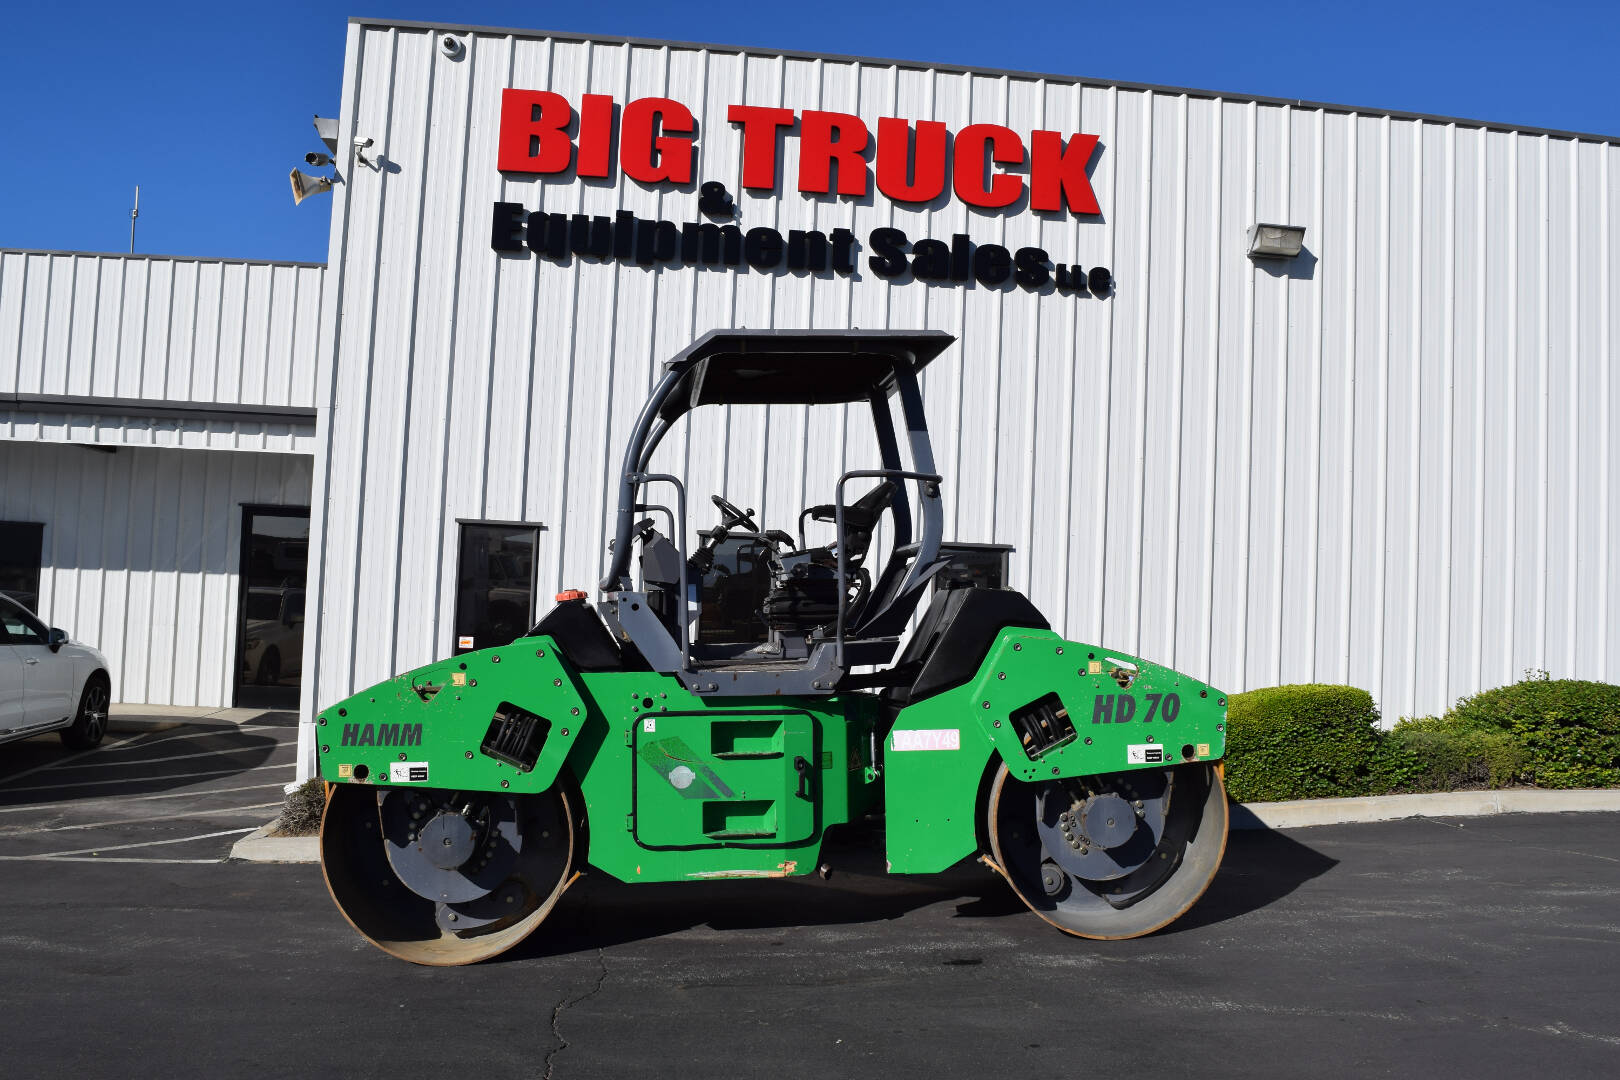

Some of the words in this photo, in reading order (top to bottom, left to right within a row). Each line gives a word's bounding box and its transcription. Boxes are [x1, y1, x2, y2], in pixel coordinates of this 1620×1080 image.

[497, 88, 694, 184] BIG
[728, 104, 1101, 215] TRUCK
[699, 181, 733, 216] &
[491, 201, 854, 274] Equipment
[868, 227, 1050, 290] Sales
[1092, 693, 1136, 724] HD
[1143, 692, 1181, 723] 70
[341, 723, 423, 747] HAMM
